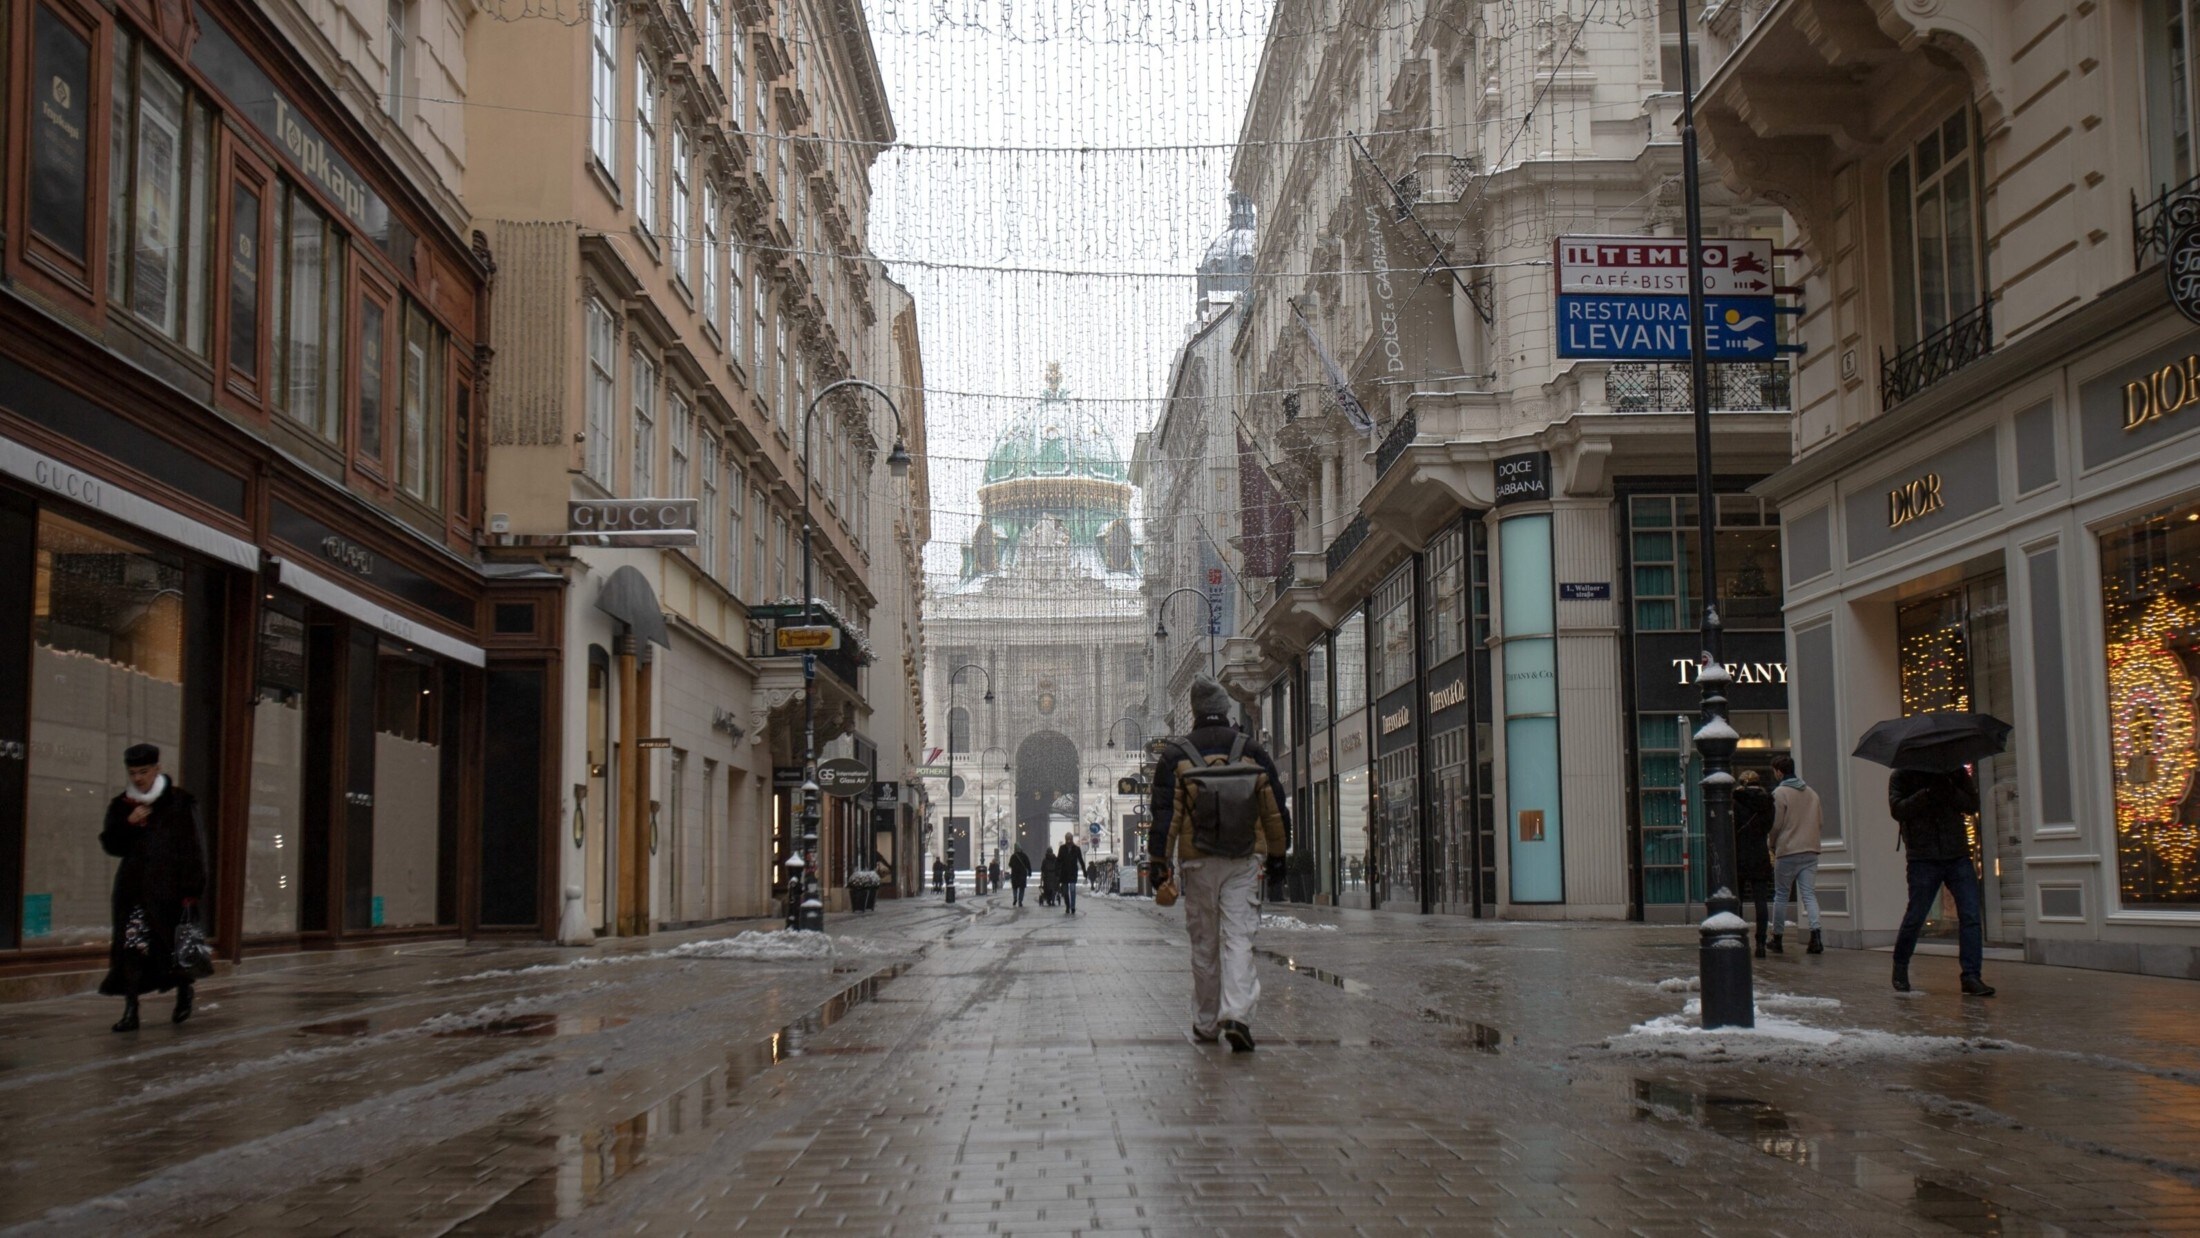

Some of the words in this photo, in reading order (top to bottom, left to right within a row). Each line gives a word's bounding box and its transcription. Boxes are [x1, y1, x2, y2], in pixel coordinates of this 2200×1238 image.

[272, 91, 366, 223] Topkapi
[1568, 247, 1595, 264] IL
[1569, 302, 1719, 321] RESTAURAT
[1499, 460, 1532, 477] DOLCE
[35, 460, 101, 507] GUCCI
[1496, 480, 1545, 498] GABBANA
[1888, 473, 1945, 528] DIOR
[573, 506, 692, 526] GUCCI
[1672, 659, 1789, 685] TIFANY
[818, 768, 835, 780] GS
